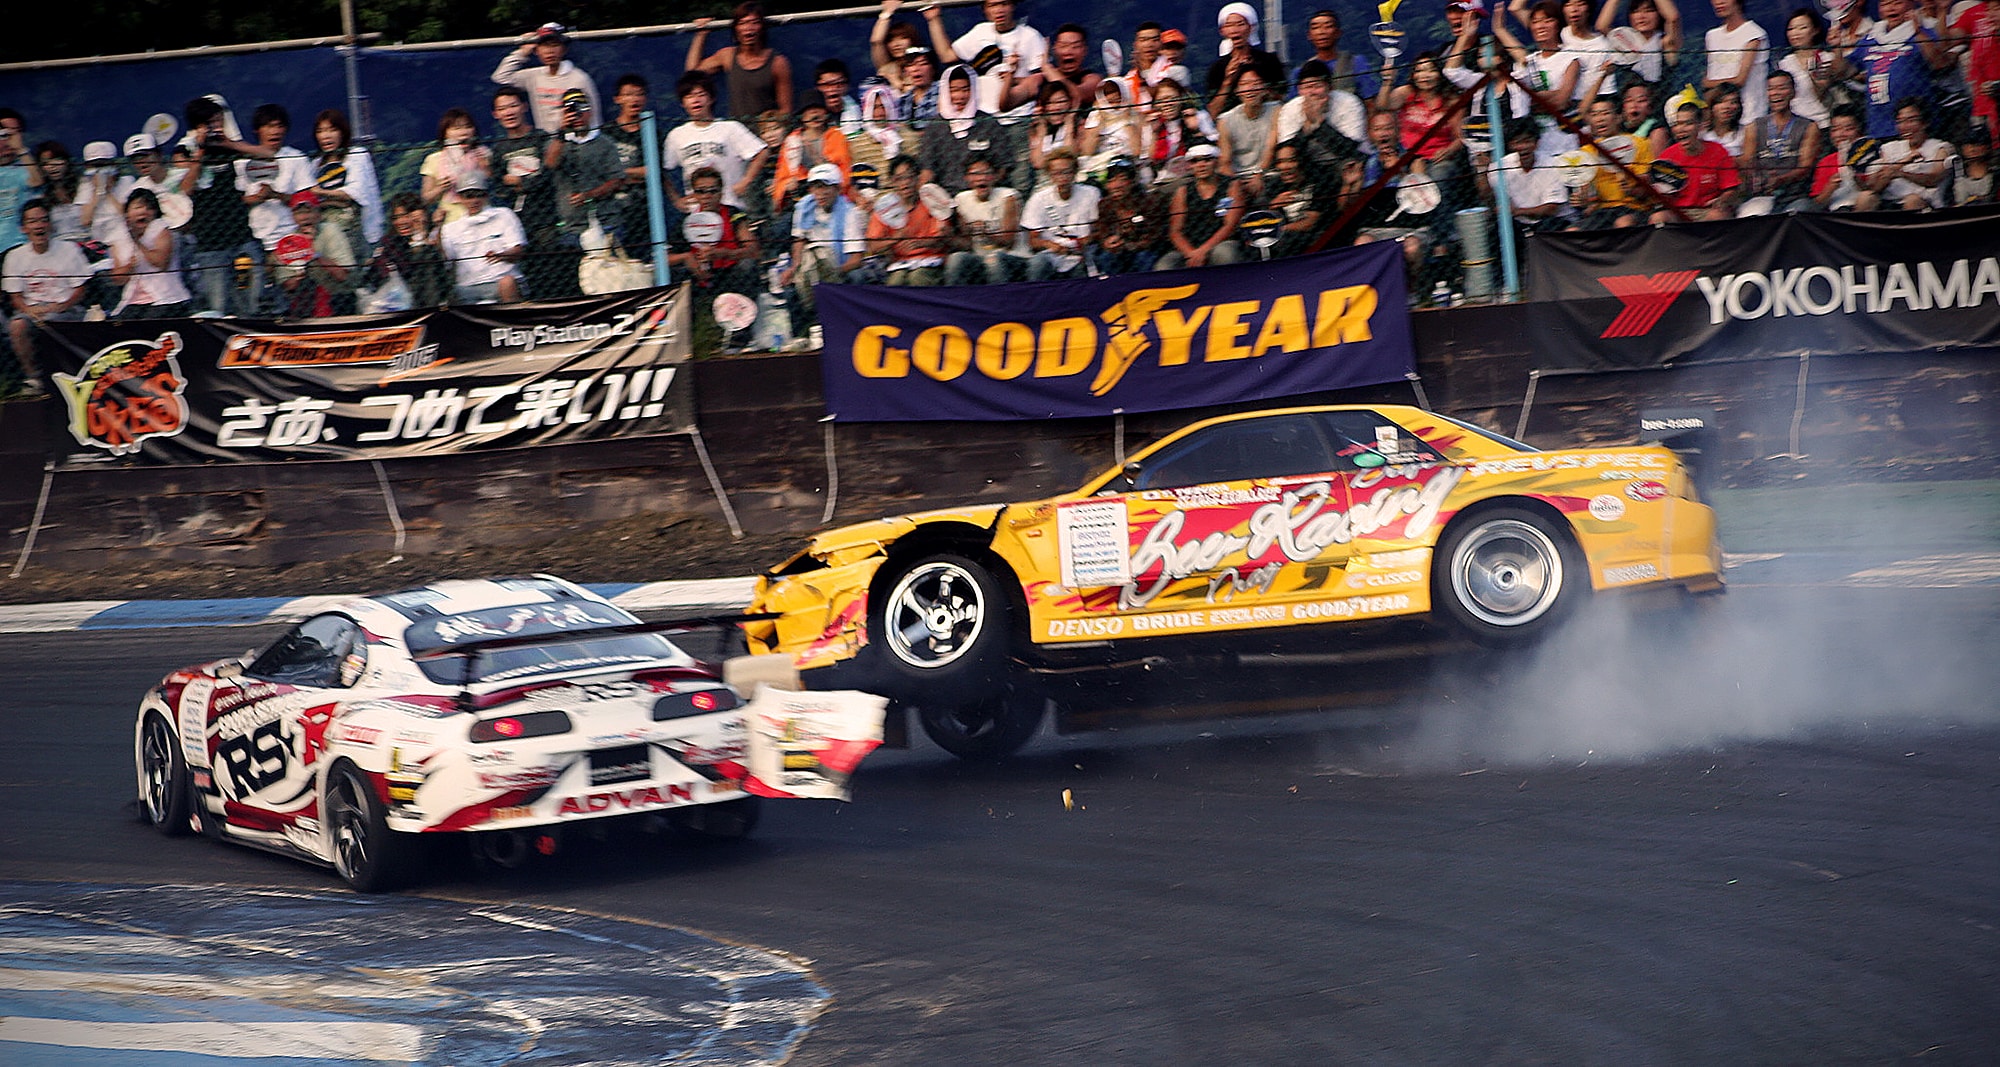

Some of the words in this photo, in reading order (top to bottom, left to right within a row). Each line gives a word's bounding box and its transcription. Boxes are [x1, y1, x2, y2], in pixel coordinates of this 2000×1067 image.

[1696, 257, 2000, 325] YOKOHAMA
[1047, 617, 1124, 638] DENSO
[1131, 613, 1205, 631] BRIDE
[1291, 594, 1410, 620] GOODYEAR
[558, 782, 696, 816] ADVAN
